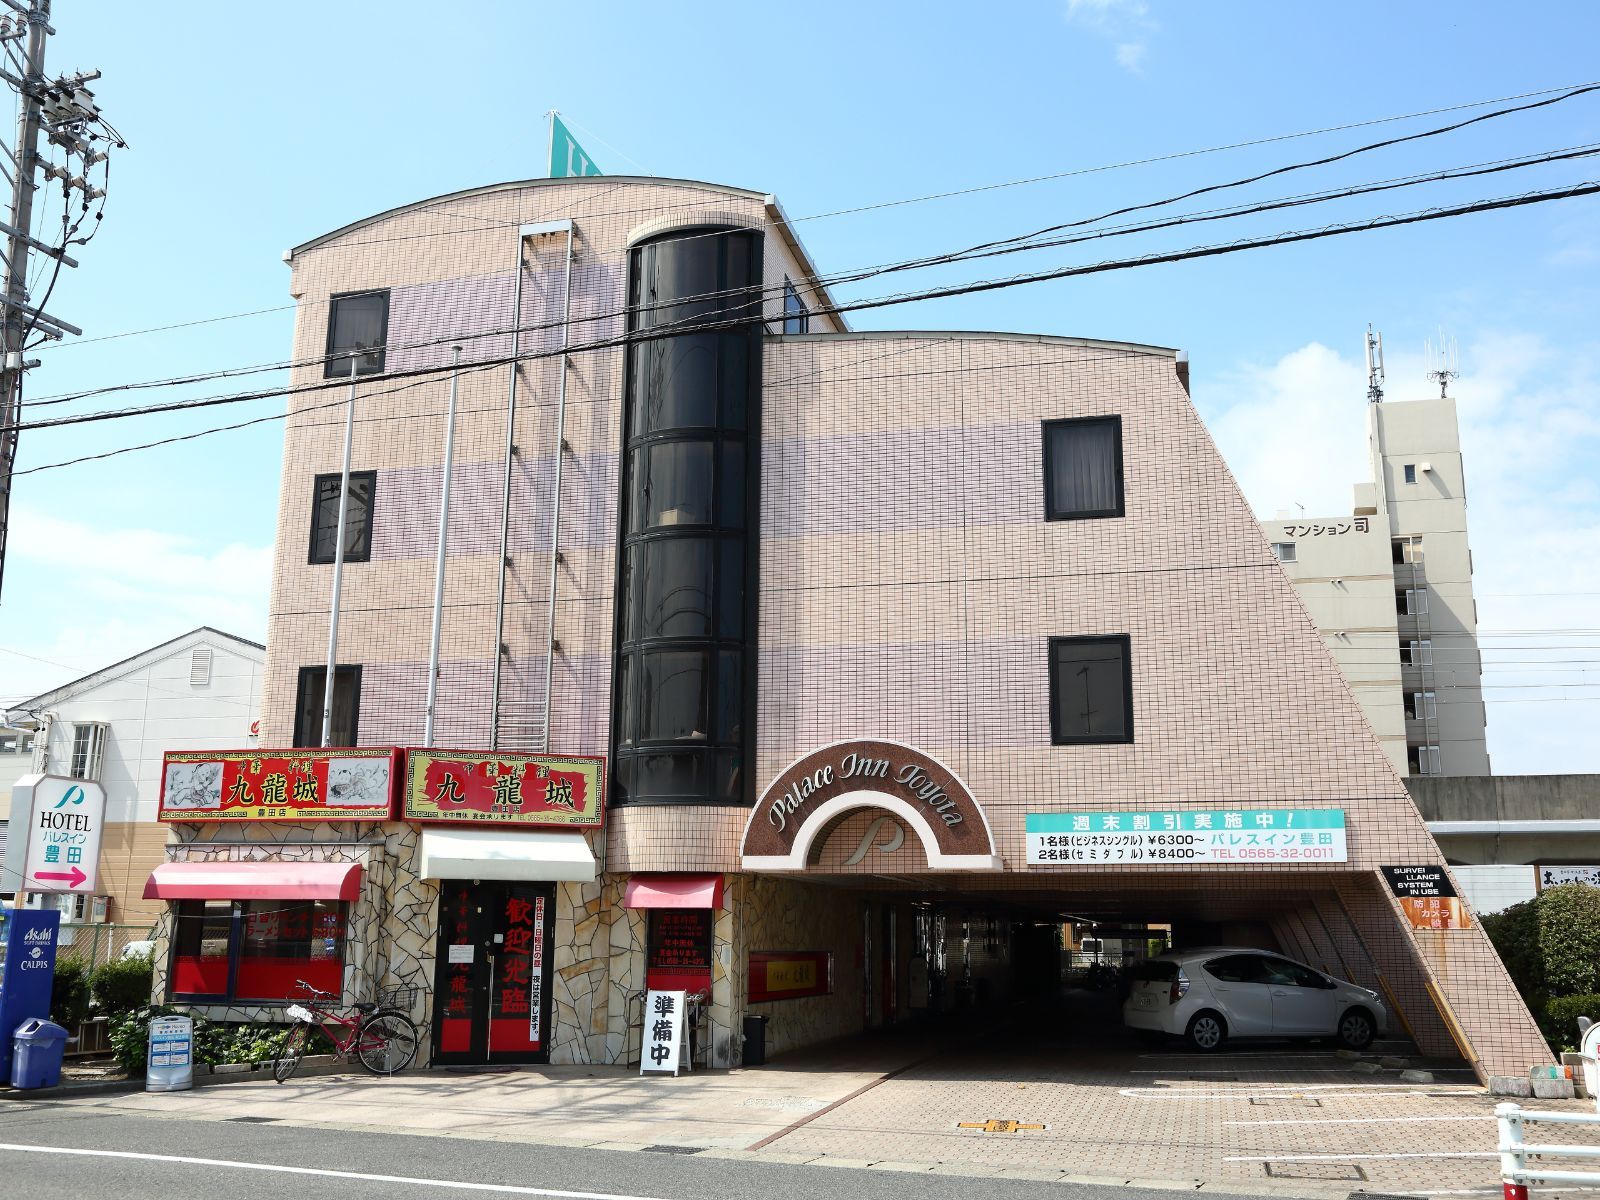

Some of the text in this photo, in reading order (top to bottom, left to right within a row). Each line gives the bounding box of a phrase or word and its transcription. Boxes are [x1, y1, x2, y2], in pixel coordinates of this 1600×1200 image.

[1283, 517, 1370, 537] マンション司
[227, 773, 319, 804] 九龍城
[434, 772, 574, 808] 九龍城
[769, 753, 963, 833] Palace Inn Toyota
[40, 811, 92, 832] HOTEL
[43, 831, 87, 844] パレスイン
[1211, 832, 1333, 845] パレスイン豊田
[44, 844, 82, 864] 豊田
[1210, 848, 1236, 859] TEL
[1238, 847, 1334, 859] 0565-32-0011
[1421, 909, 1450, 918] カメラ
[24, 927, 53, 941] Asahi
[20, 960, 48, 971] CALPIS
[650, 995, 675, 1066] 準備中
